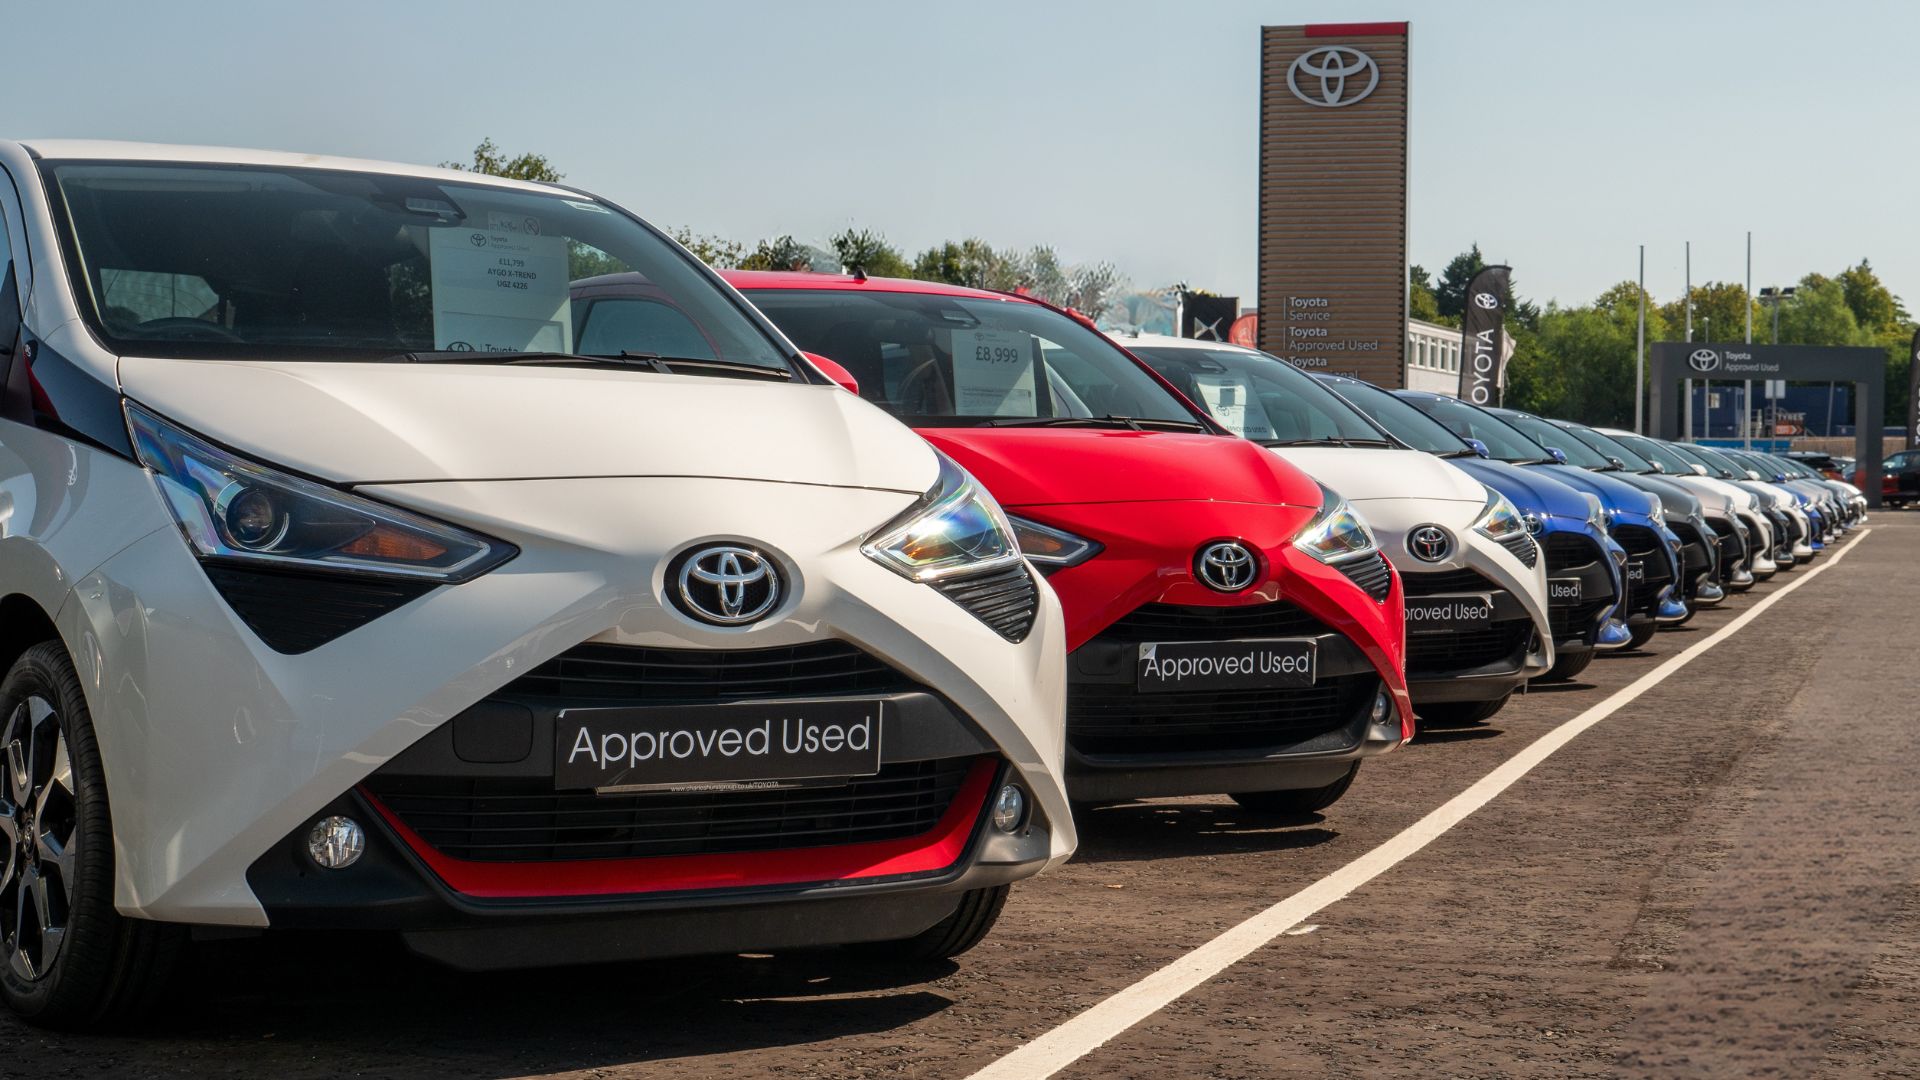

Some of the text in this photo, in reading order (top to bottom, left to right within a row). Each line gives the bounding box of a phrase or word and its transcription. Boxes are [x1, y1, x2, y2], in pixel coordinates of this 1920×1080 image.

[488, 268, 537, 279] AYGO X-TREND
[497, 280, 528, 290] UGZ 4226
[1289, 296, 1328, 309] Toyota
[1289, 310, 1330, 321] Service
[1289, 326, 1328, 339] Toyota
[1289, 340, 1378, 352] Approved Used
[976, 346, 1018, 364] £8,999
[1726, 351, 1751, 362] Toyota
[1289, 355, 1328, 369] Toyota
[1471, 328, 1494, 405] OYOTA
[1725, 363, 1779, 373] Approved Used
[1628, 568, 1642, 580] ed
[1551, 583, 1578, 598] Used
[1404, 603, 1488, 620] proved Used
[1144, 651, 1309, 681] Approved Used
[568, 715, 870, 770] Approved Used
